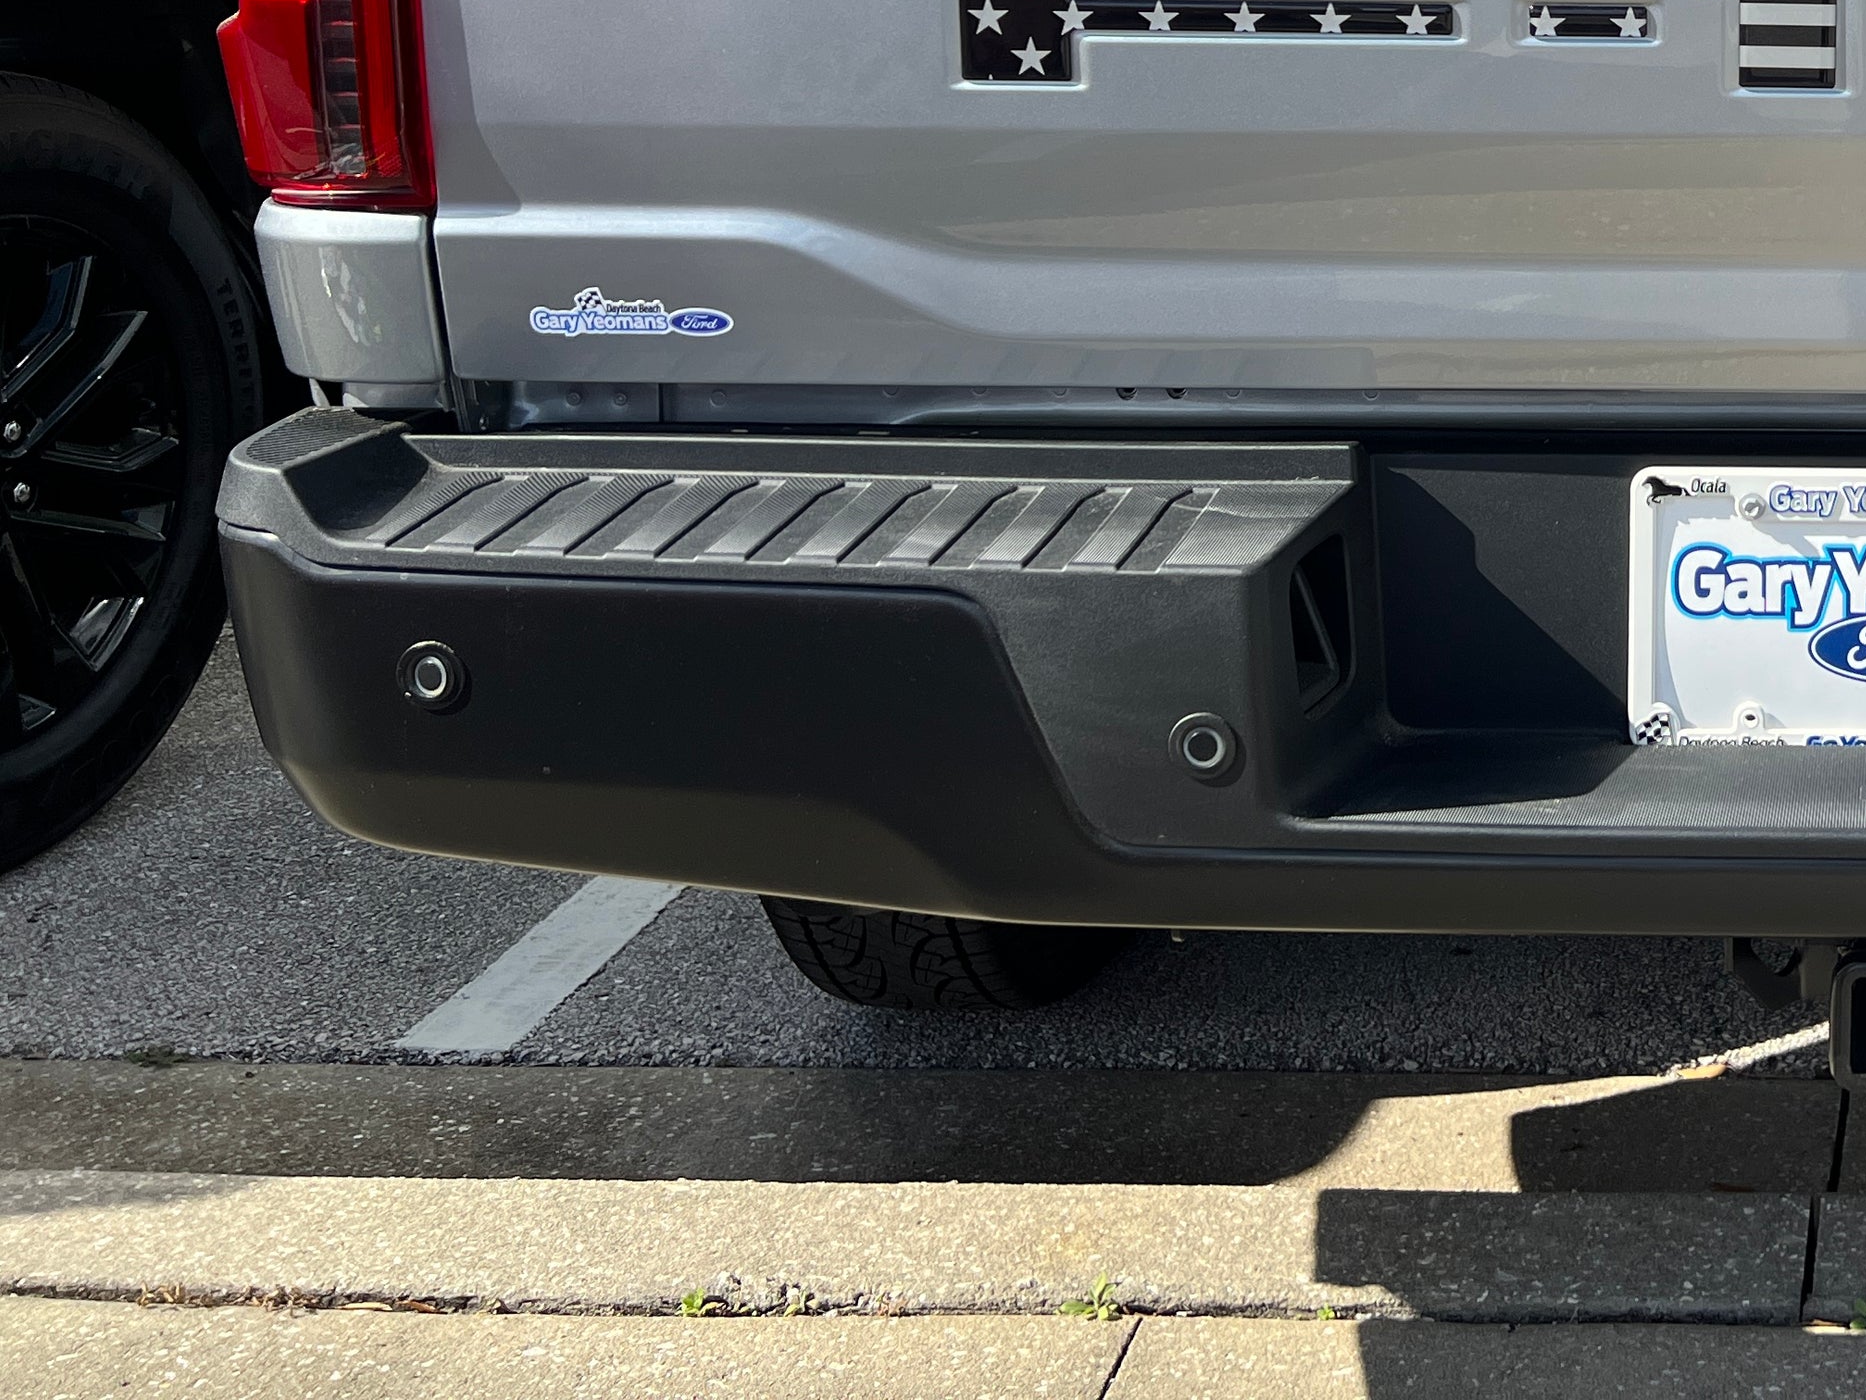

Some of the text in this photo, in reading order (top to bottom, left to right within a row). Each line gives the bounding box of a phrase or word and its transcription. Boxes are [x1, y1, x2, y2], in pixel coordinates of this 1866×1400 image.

[606, 303, 662, 315] Daytona Beach
[680, 314, 718, 330] Ford
[1690, 478, 1727, 494] Ocala
[1769, 485, 1838, 517] Gary
